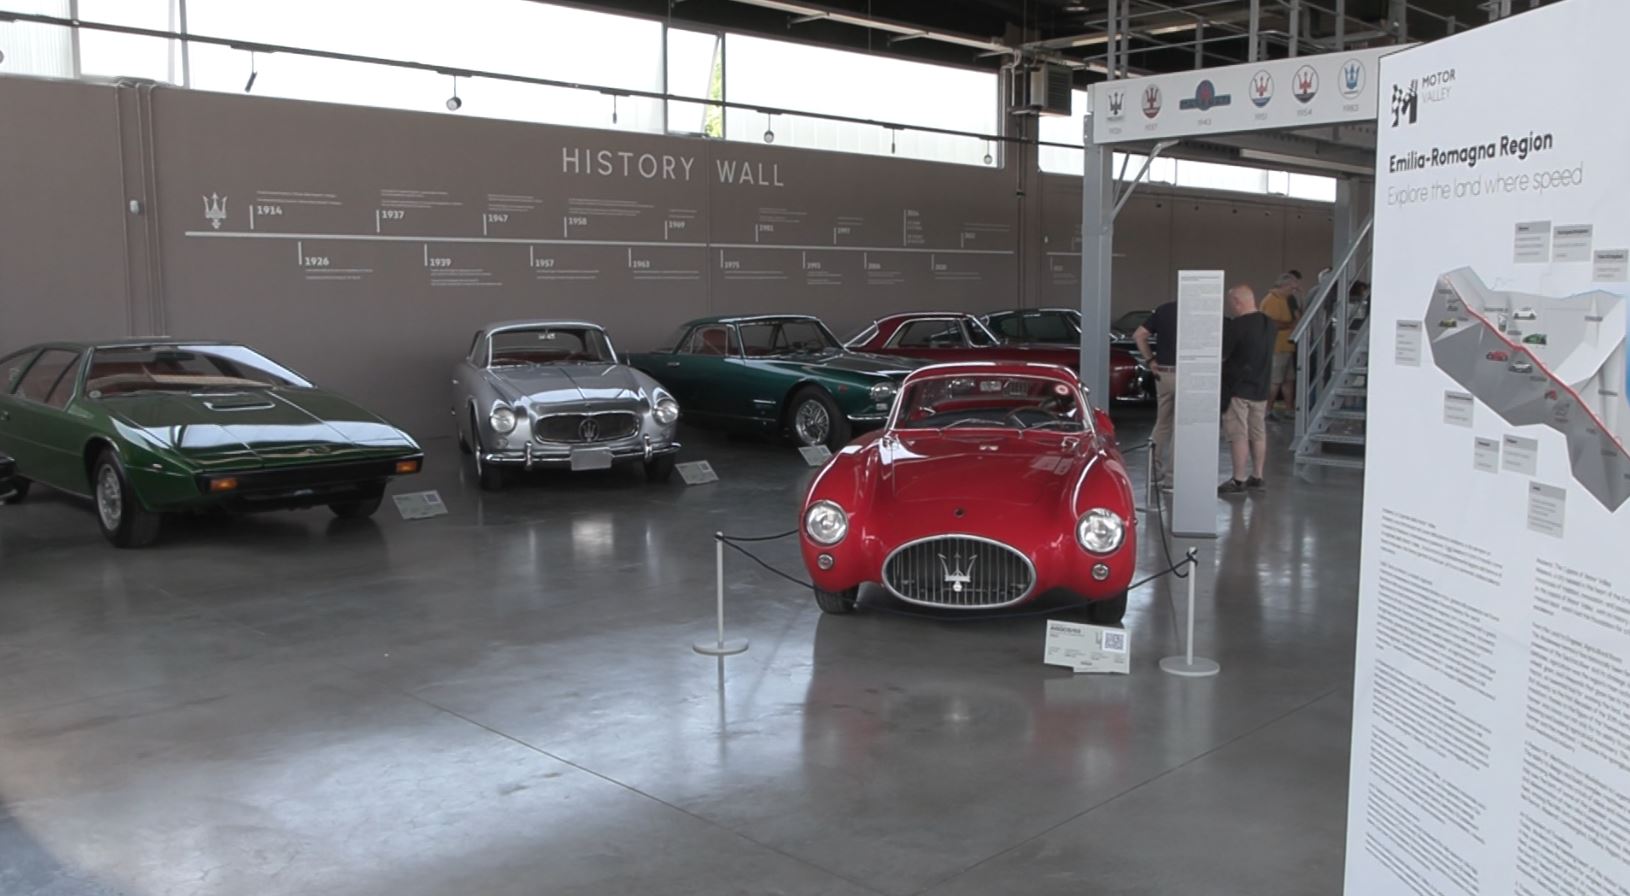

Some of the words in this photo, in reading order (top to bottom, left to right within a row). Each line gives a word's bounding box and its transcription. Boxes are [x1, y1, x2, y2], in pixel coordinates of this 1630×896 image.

[1422, 69, 1456, 89] MOTOR
[1422, 87, 1452, 103] VALLEY
[1389, 142, 1496, 173] Emilia-Romagna
[1499, 131, 1553, 161] Region
[562, 147, 694, 181] HISTORY
[716, 159, 784, 187] WALL
[1388, 184, 1429, 208] Explore
[1431, 180, 1451, 200] the
[1454, 175, 1481, 198] land
[1485, 174, 1529, 195] where
[1533, 161, 1583, 196] speed
[257, 205, 283, 216] 1914
[382, 210, 405, 220] 1937
[488, 214, 509, 223] 1947
[568, 217, 587, 226] 1958
[304, 256, 330, 266] 1926
[430, 258, 452, 267] 1939
[535, 259, 555, 268] 1957
